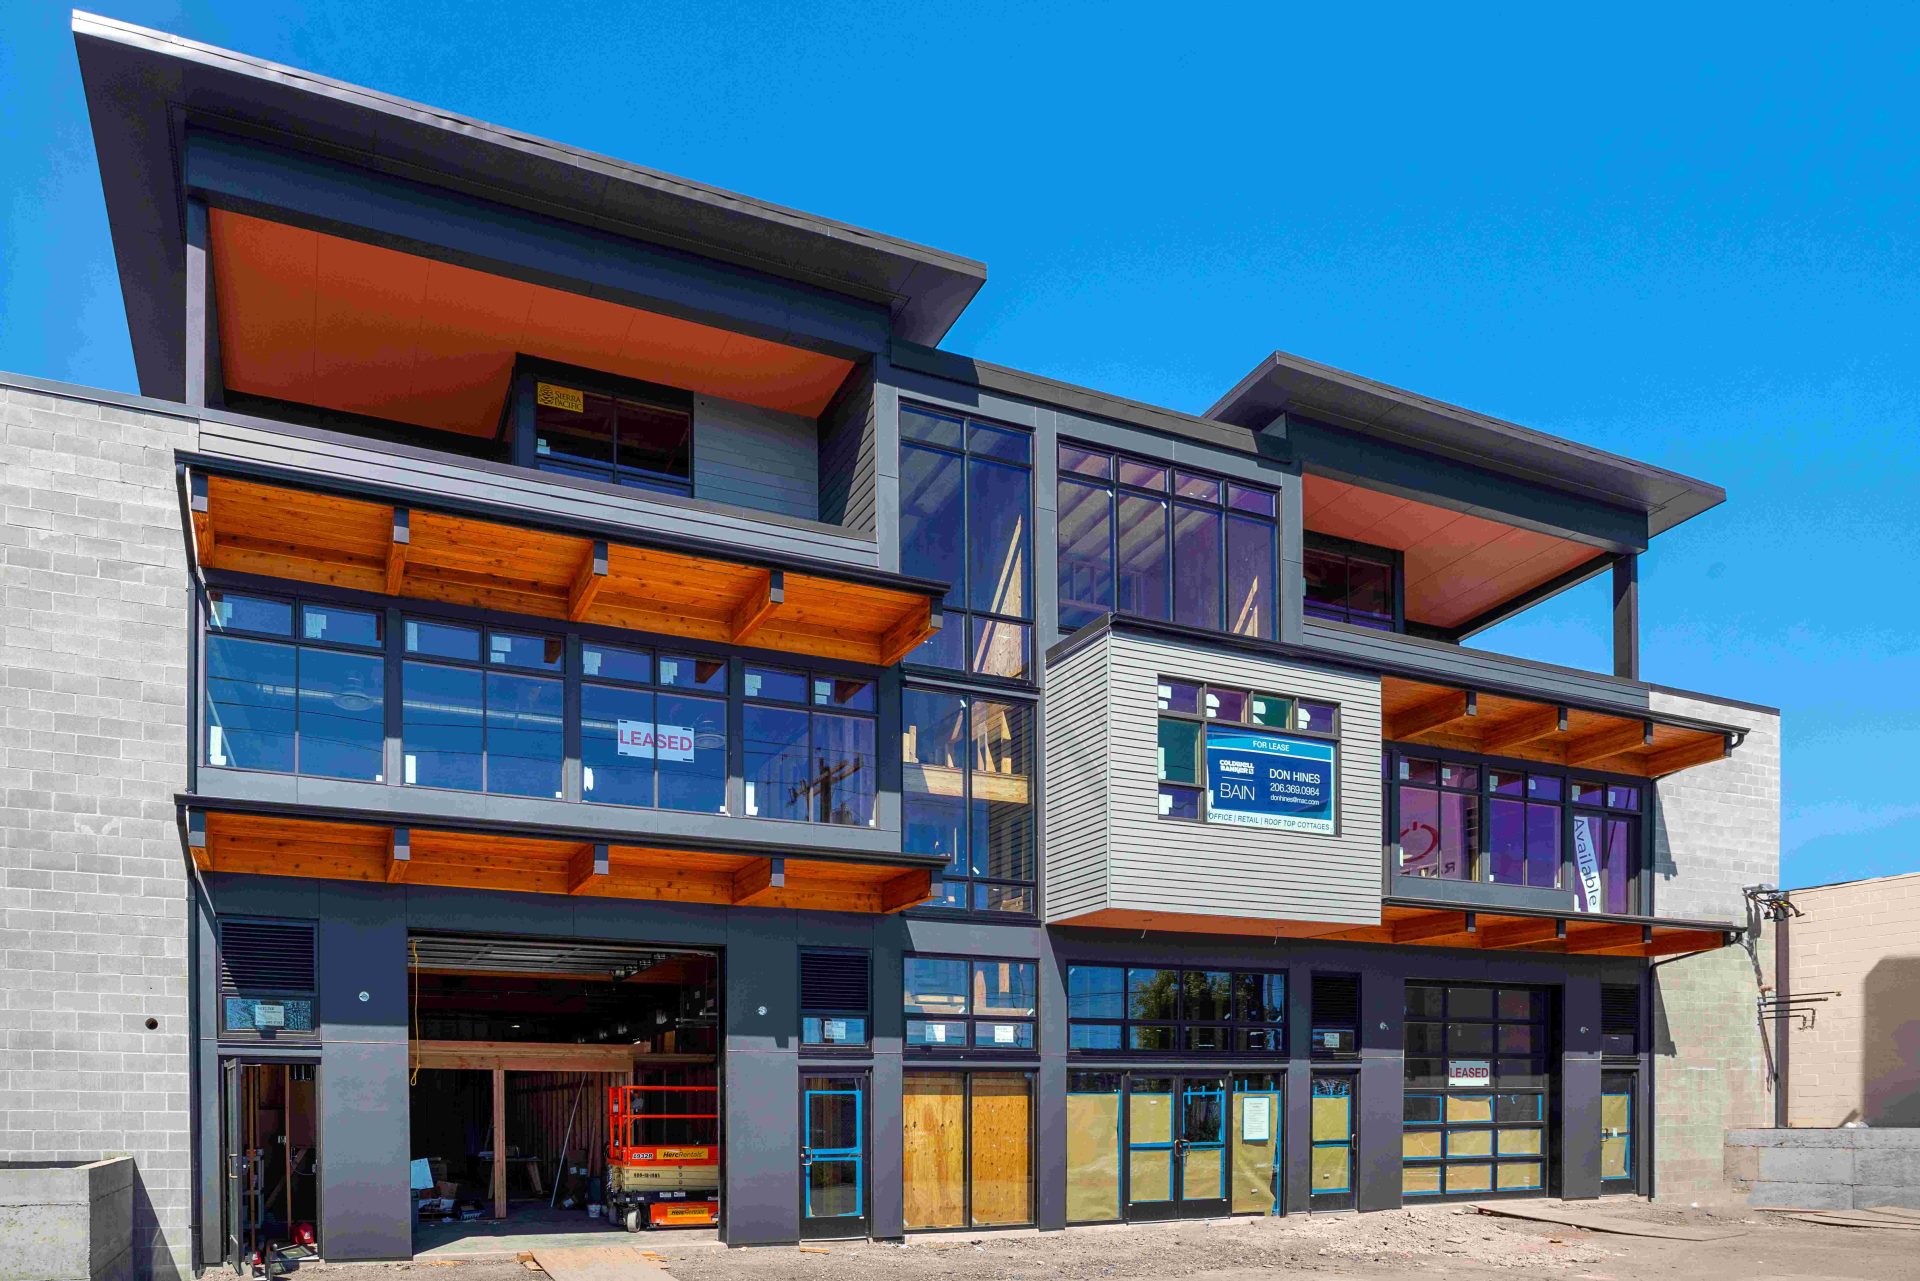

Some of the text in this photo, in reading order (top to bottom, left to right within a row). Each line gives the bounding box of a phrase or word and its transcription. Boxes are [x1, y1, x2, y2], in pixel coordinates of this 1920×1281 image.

[554, 390, 581, 403] SIERRA
[554, 398, 583, 411] PACIFIC
[619, 729, 693, 752] LEASED
[1252, 740, 1290, 752] FOR LEASE
[1219, 759, 1255, 769] COLDWELL
[1220, 765, 1249, 774] BANKER
[1269, 768, 1321, 784] DON HINES
[1220, 783, 1255, 800] BAIN
[1270, 782, 1320, 797] 206.369.0984
[1270, 794, 1320, 806] donhines@mac.com
[1208, 812, 1330, 831] OFFICE RETAIL ROOF TOP COTTAGES
[1574, 819, 1599, 906] Available
[1449, 1067, 1489, 1079] LEASED
